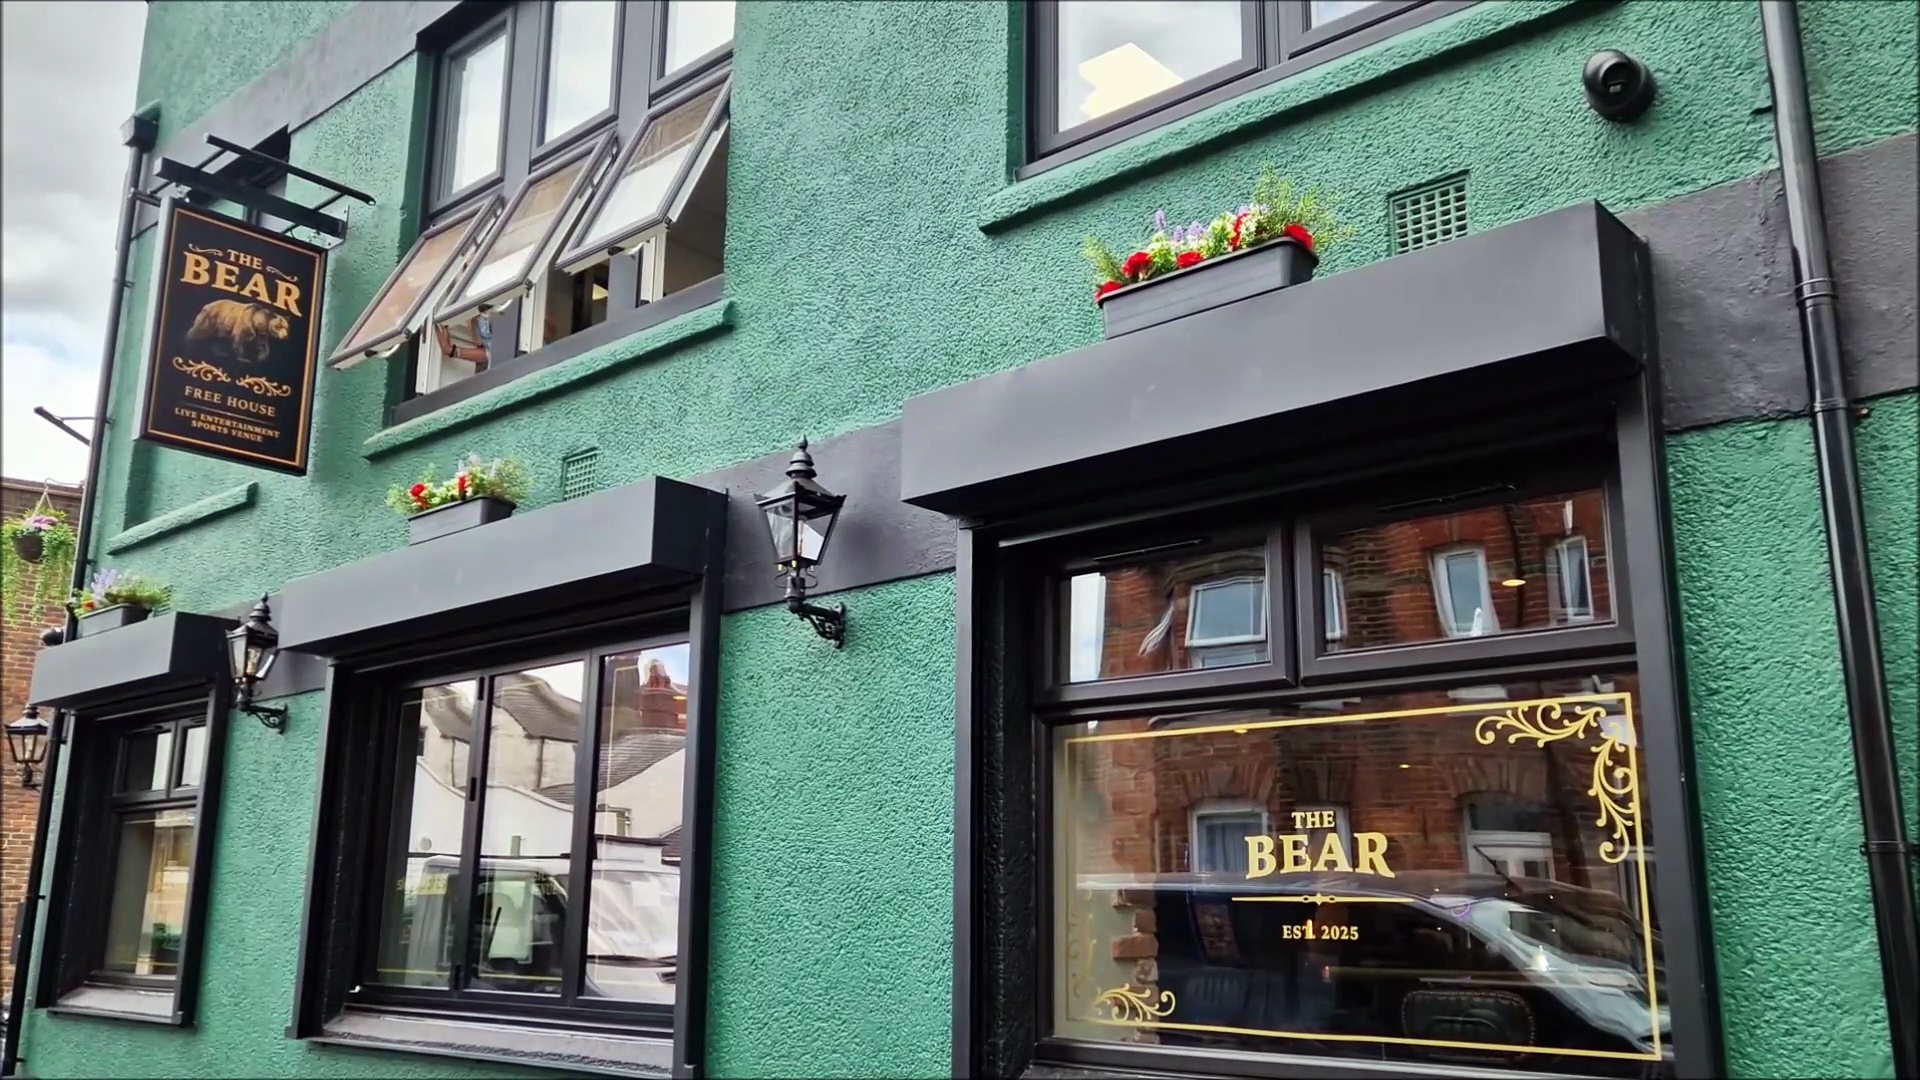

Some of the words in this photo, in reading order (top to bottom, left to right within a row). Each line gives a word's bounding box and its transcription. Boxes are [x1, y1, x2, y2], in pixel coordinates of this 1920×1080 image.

[227, 249, 263, 270] THE
[180, 251, 302, 317] BEAR
[184, 385, 222, 404] FREE
[227, 395, 276, 417] HOUSE
[174, 407, 198, 419] LIVE
[200, 413, 281, 438] ENTERTAINMENT
[191, 420, 229, 435] SPORTS
[231, 429, 264, 443] VENUE
[1291, 811, 1335, 829] THE
[1244, 832, 1396, 880] BEAR
[1321, 926, 1359, 940] 2025
